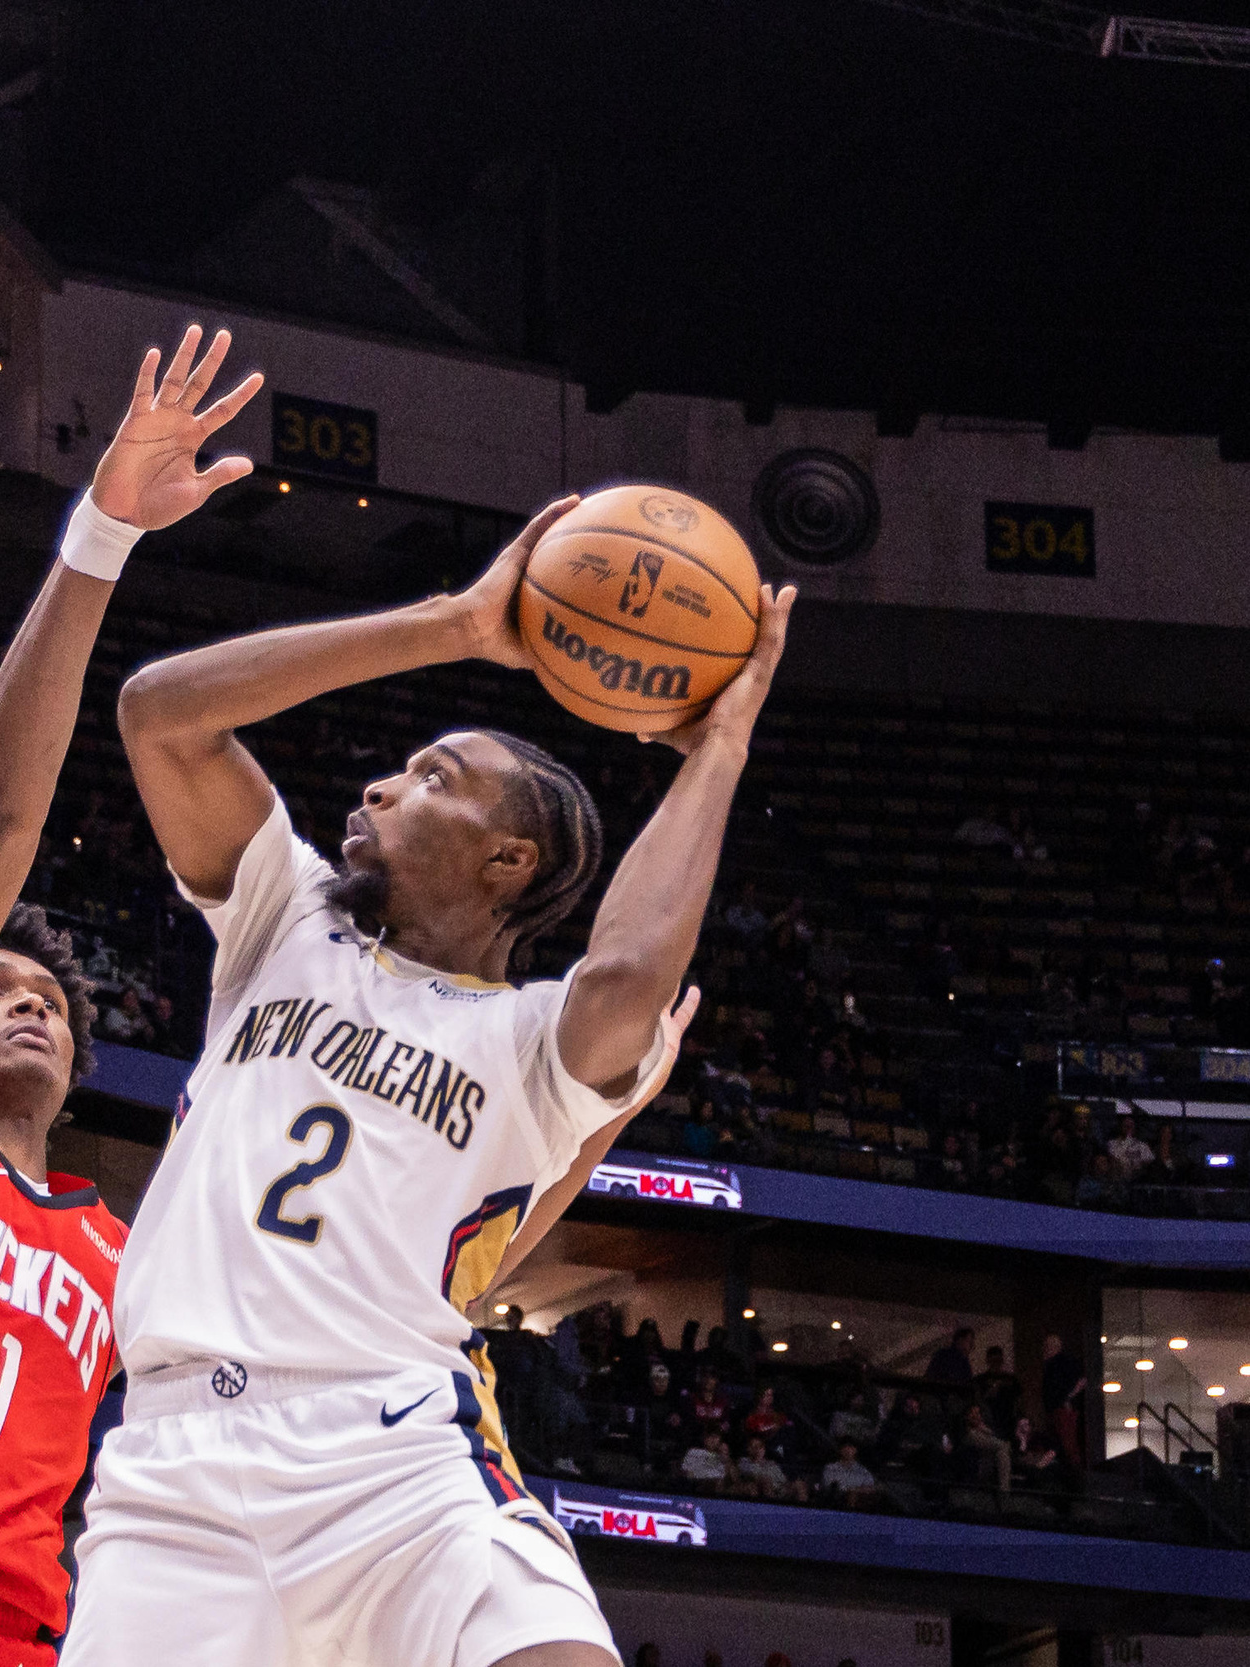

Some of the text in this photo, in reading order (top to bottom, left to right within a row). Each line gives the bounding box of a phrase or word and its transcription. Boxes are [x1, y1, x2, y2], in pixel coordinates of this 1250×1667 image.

[280, 409, 372, 467] 303
[991, 516, 1089, 564] 304
[223, 997, 488, 1154] NEW ORLEANS
[253, 1101, 355, 1248] 2
[639, 1173, 694, 1200] NOLA
[602, 1509, 657, 1539] NOLA
